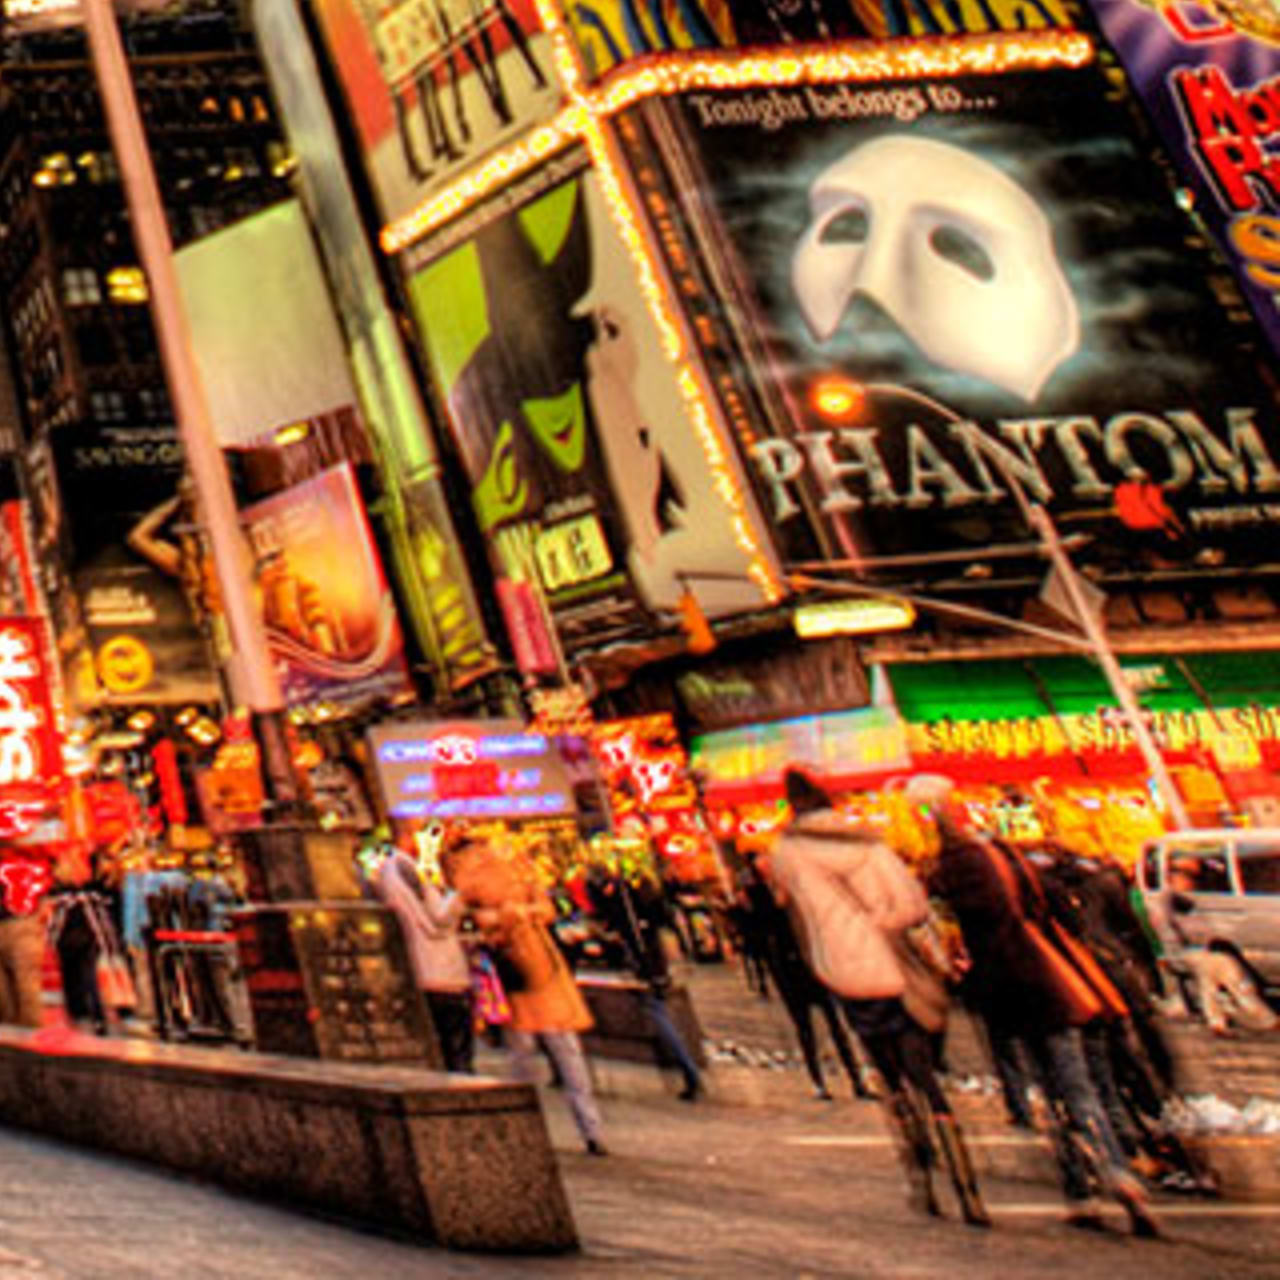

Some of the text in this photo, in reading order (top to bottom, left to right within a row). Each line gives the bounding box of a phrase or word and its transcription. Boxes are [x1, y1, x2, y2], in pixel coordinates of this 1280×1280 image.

[691, 92, 808, 130] Tonight
[805, 83, 929, 122] belongs
[751, 406, 1280, 522] PHANTOM
